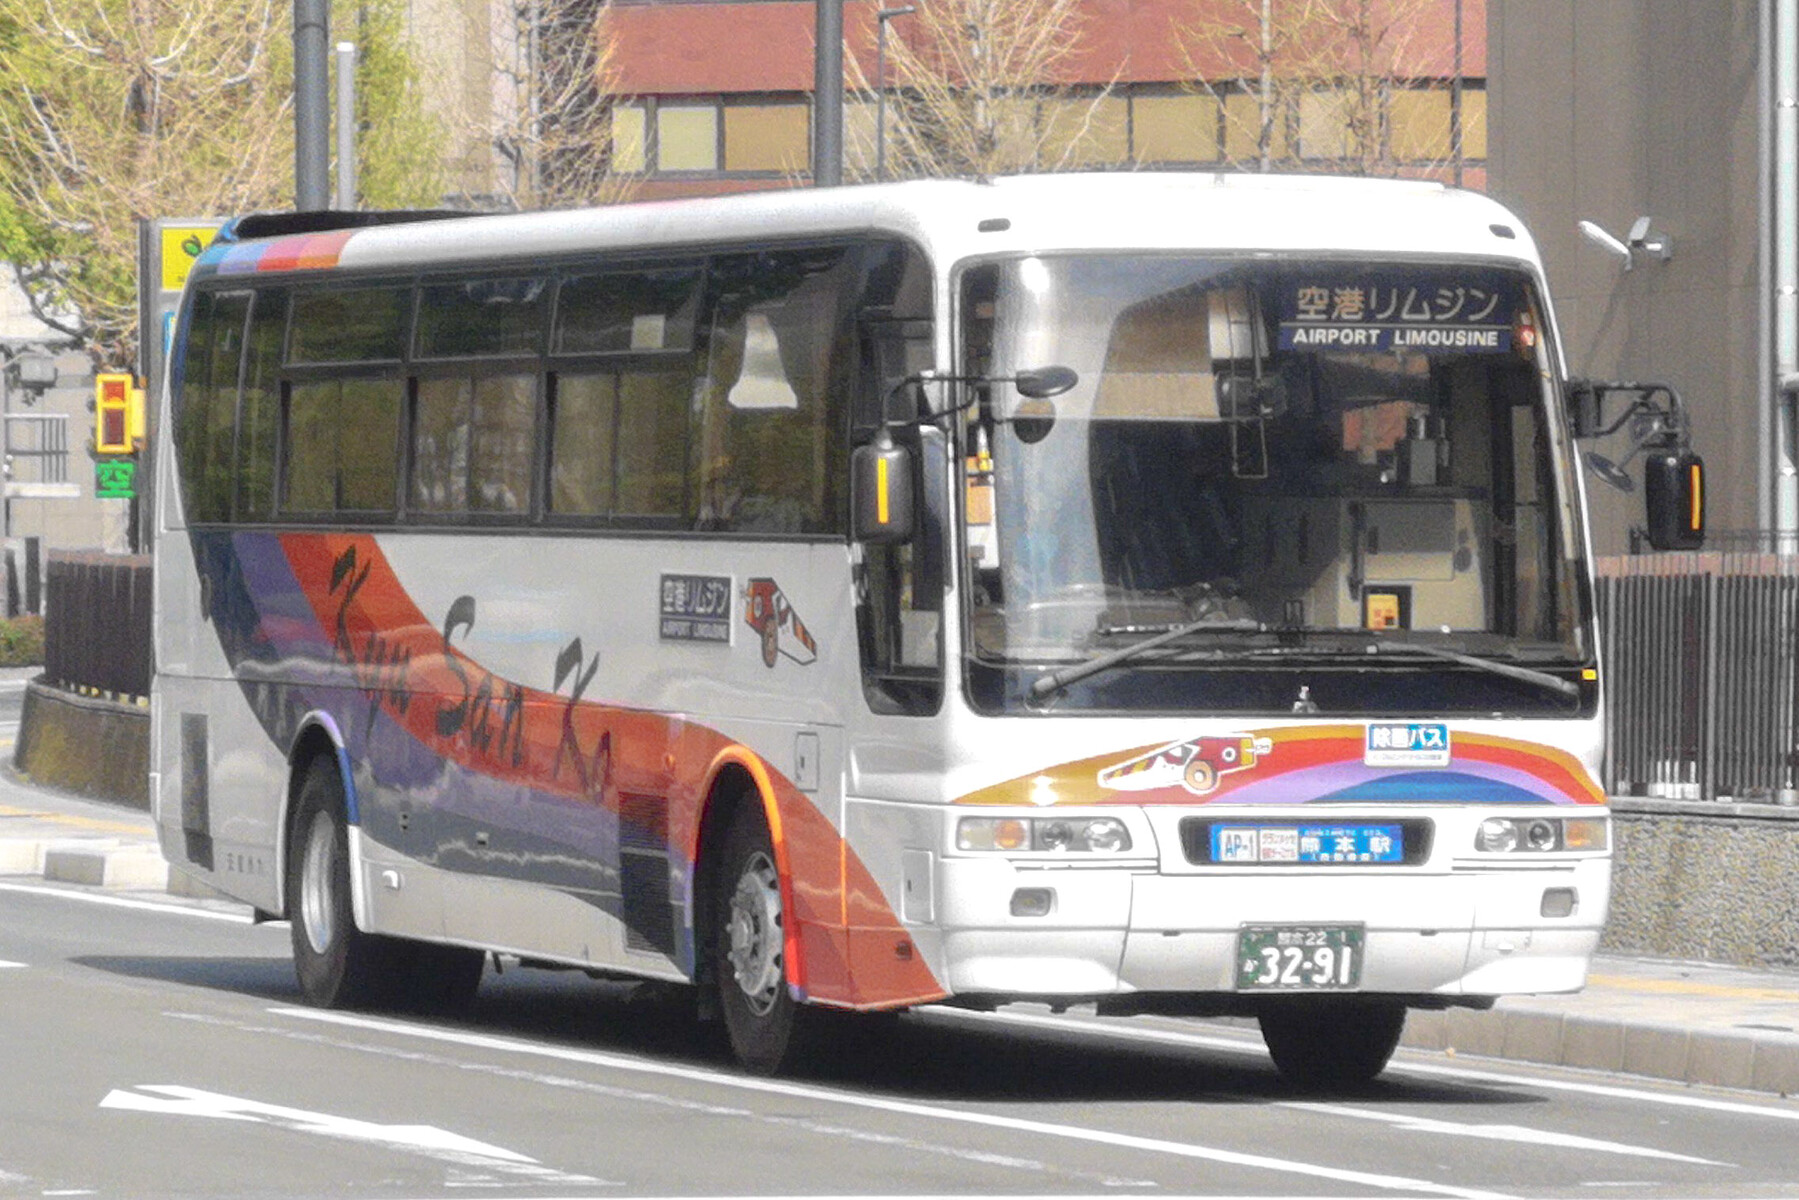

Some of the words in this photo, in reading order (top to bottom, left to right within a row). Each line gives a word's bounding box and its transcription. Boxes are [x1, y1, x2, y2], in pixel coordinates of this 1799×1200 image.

[1296, 286, 1498, 322] 空港リムジン
[1293, 328, 1380, 345] AIRPORT
[1394, 329, 1498, 347] LIMOUSINE
[95, 459, 136, 499] 空
[1225, 833, 1254, 858] AP-1
